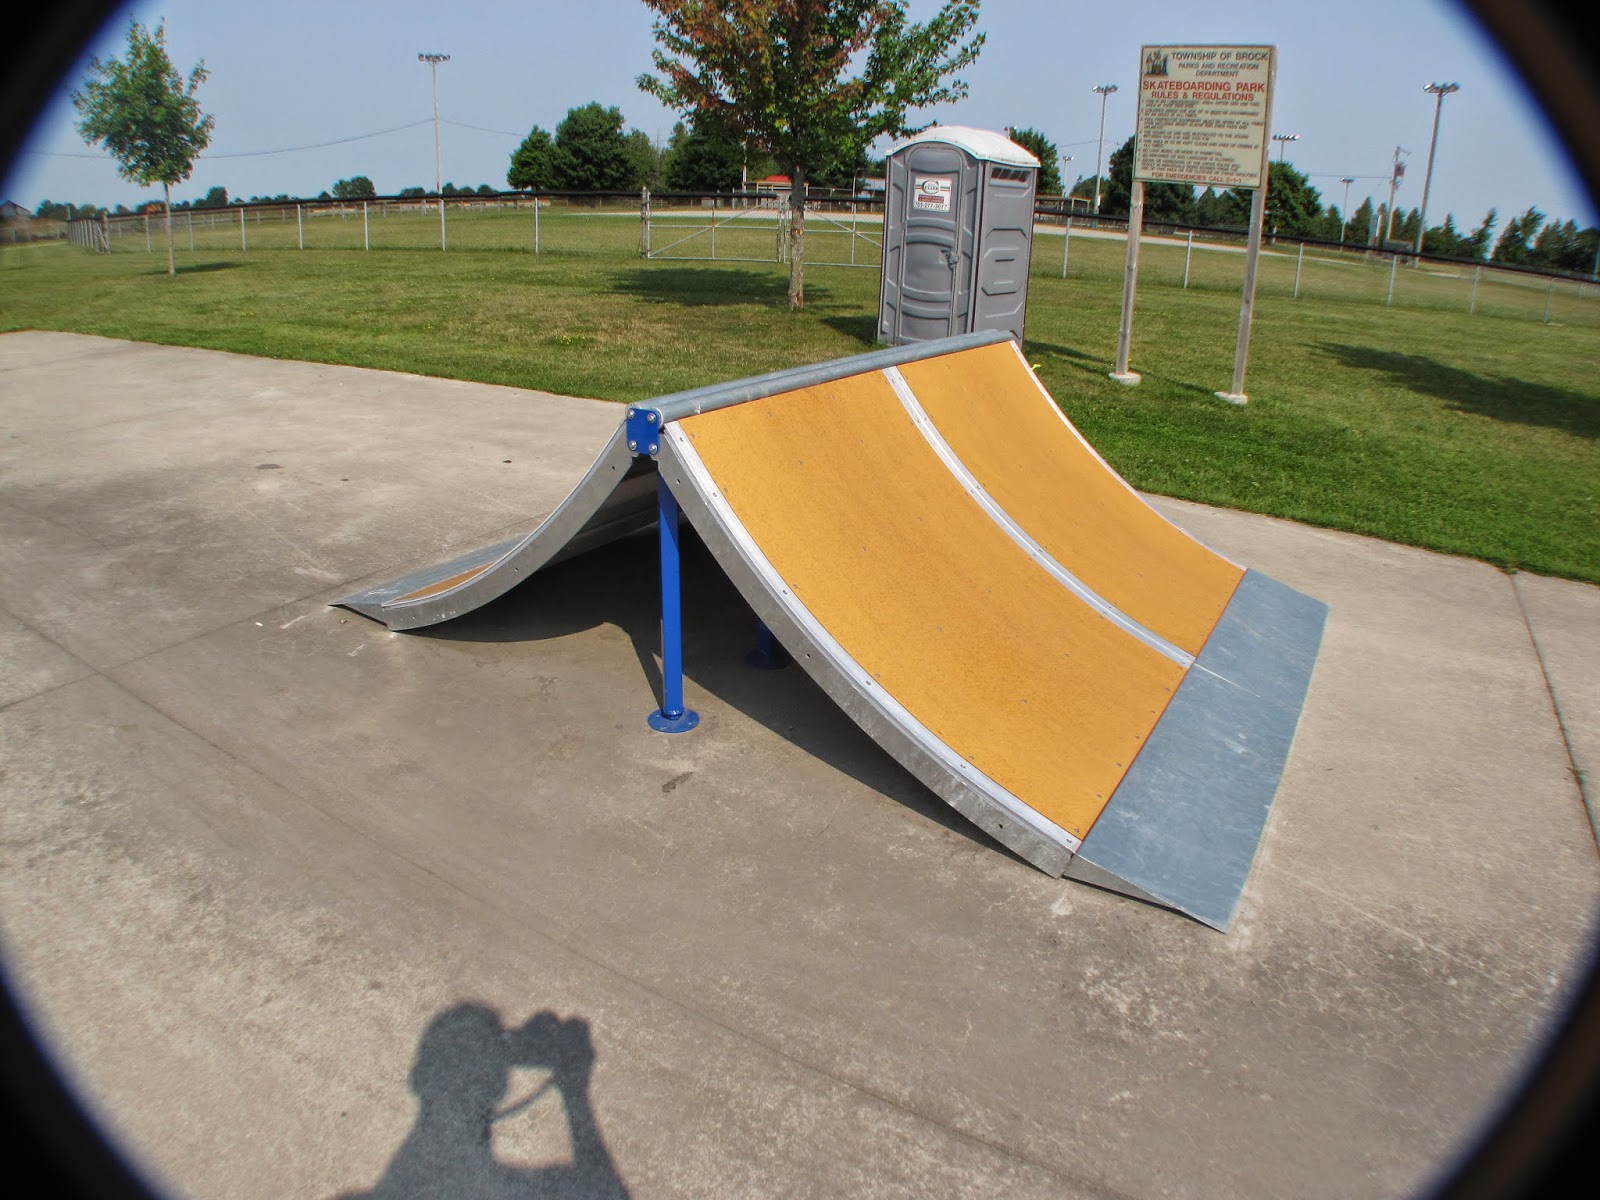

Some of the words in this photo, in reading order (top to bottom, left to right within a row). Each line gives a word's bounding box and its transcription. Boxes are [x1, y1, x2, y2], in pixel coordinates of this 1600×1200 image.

[1171, 52, 1217, 60] TOWNSHIP
[1220, 52, 1232, 60] OF
[1235, 52, 1268, 61] BROCK
[1143, 81, 1230, 91] SKATEBOARDING
[1236, 83, 1265, 93] PARK
[1151, 91, 1178, 99] RULES
[1192, 92, 1254, 101] REGULATIONS
[1165, 172, 1207, 180] EMERGENCIES
